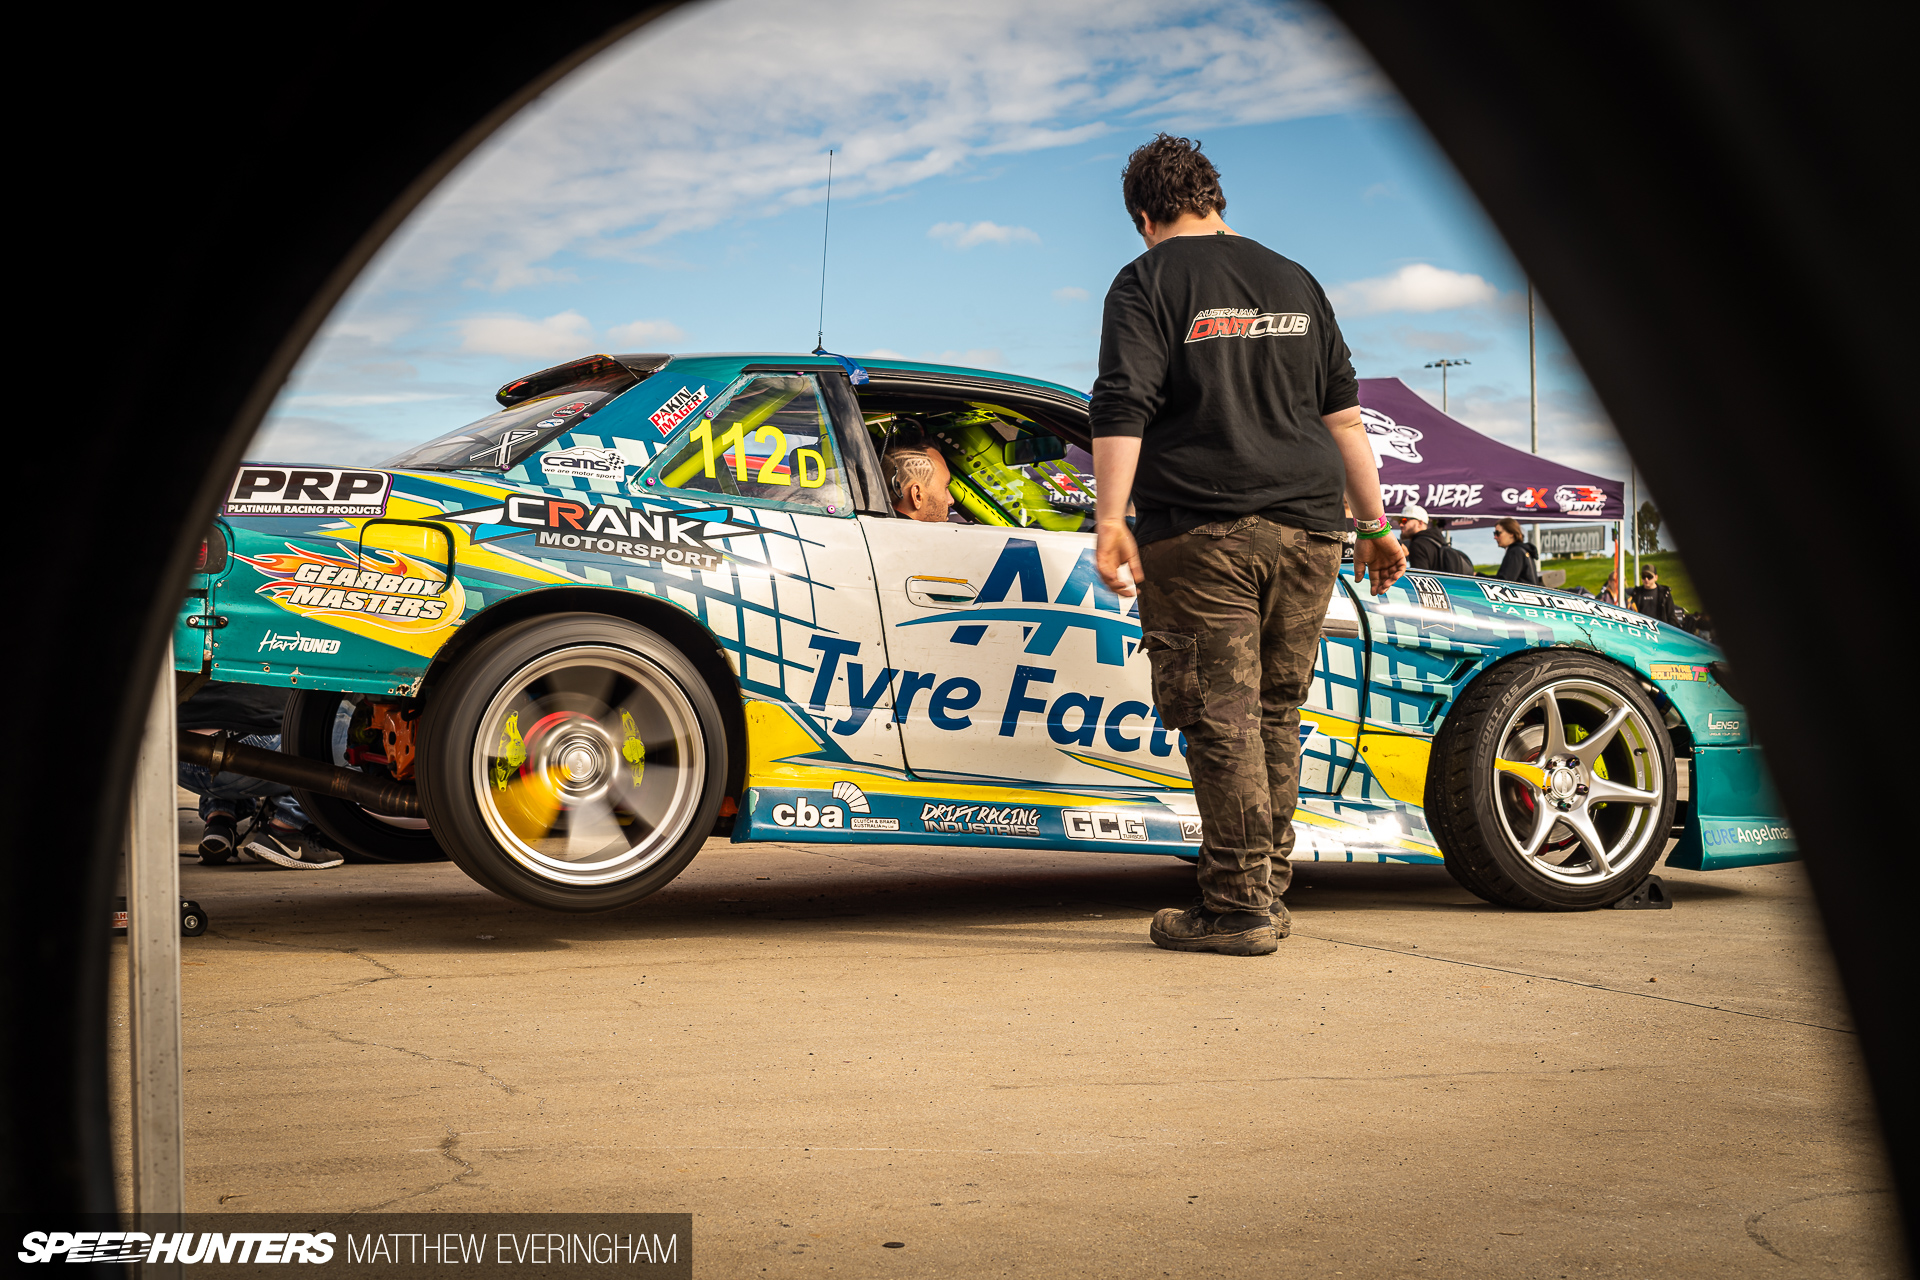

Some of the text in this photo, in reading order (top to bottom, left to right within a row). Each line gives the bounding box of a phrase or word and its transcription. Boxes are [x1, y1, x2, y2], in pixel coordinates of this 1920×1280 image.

[1198, 308, 1259, 318] AUSTRALIAN
[650, 388, 692, 427] PAKIN
[658, 391, 708, 436] IMAGERY
[234, 469, 384, 501] PRP
[1379, 484, 1484, 508] RTS HERE
[1501, 487, 1548, 508] G4X
[228, 504, 382, 515] PLATINUM RACING PRODUCTS
[507, 496, 703, 548] CRANK
[539, 531, 717, 568] MOTORSPORT
[294, 563, 446, 598] GEARBOX
[1415, 576, 1442, 594] PRO
[287, 585, 447, 619] MASTERS
[1420, 592, 1447, 609] WRAPS
[1492, 605, 1659, 643] FABRICATION
[1651, 671, 1693, 681] SOLUTIONS
[808, 634, 1318, 758] Tyre Fact
[1477, 684, 1520, 768] SPORT RS
[772, 797, 843, 828] cba
[920, 802, 1041, 825] DRIFT RACING
[1063, 811, 1147, 840] GCG
[924, 820, 1040, 836] INDUSTRIES
[1704, 824, 1793, 846] CUREAngelma
